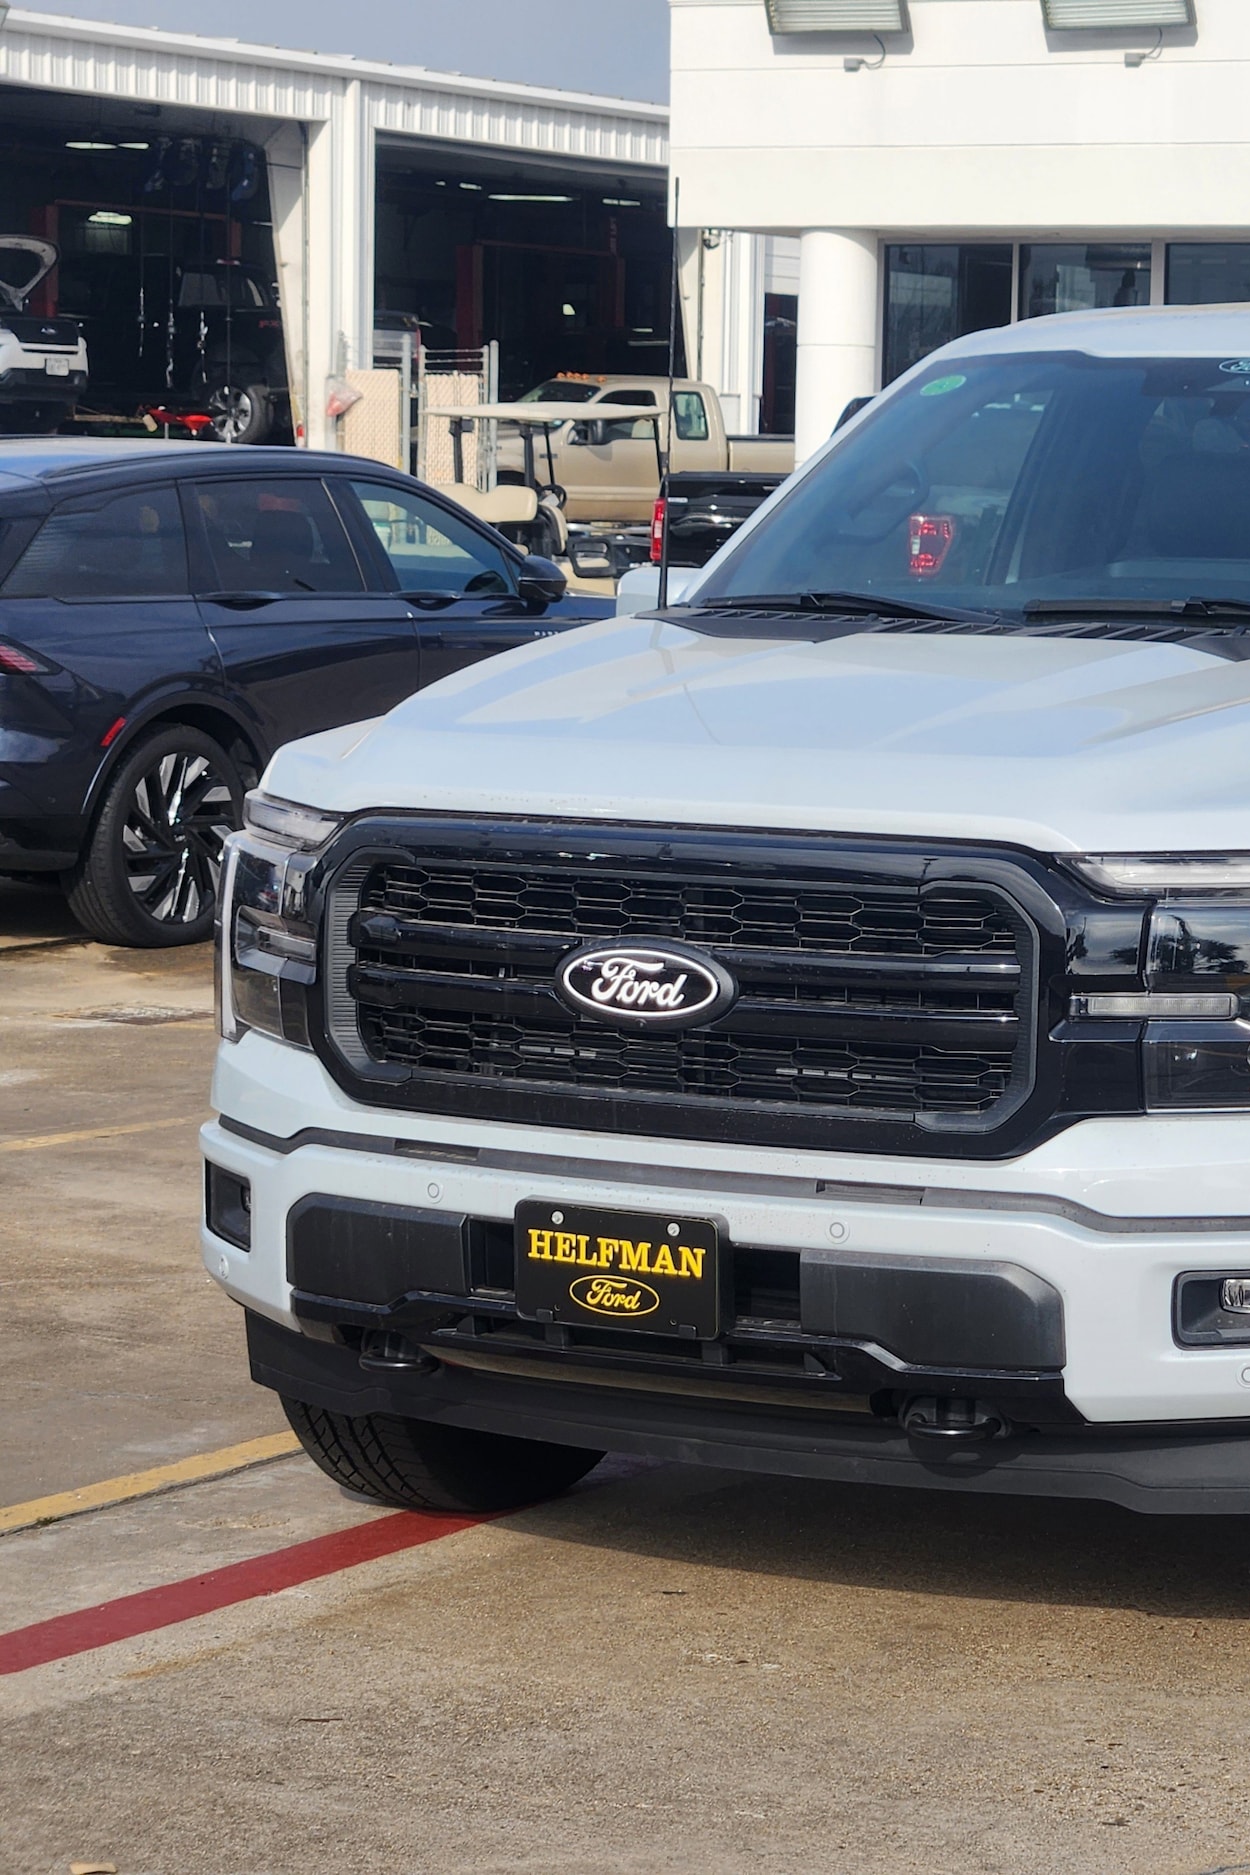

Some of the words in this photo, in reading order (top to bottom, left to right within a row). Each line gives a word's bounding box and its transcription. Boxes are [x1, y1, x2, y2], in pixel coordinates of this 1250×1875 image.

[591, 957, 688, 1007] Ford
[527, 1228, 706, 1278] HELFMAN
[586, 1278, 641, 1310] Ford
